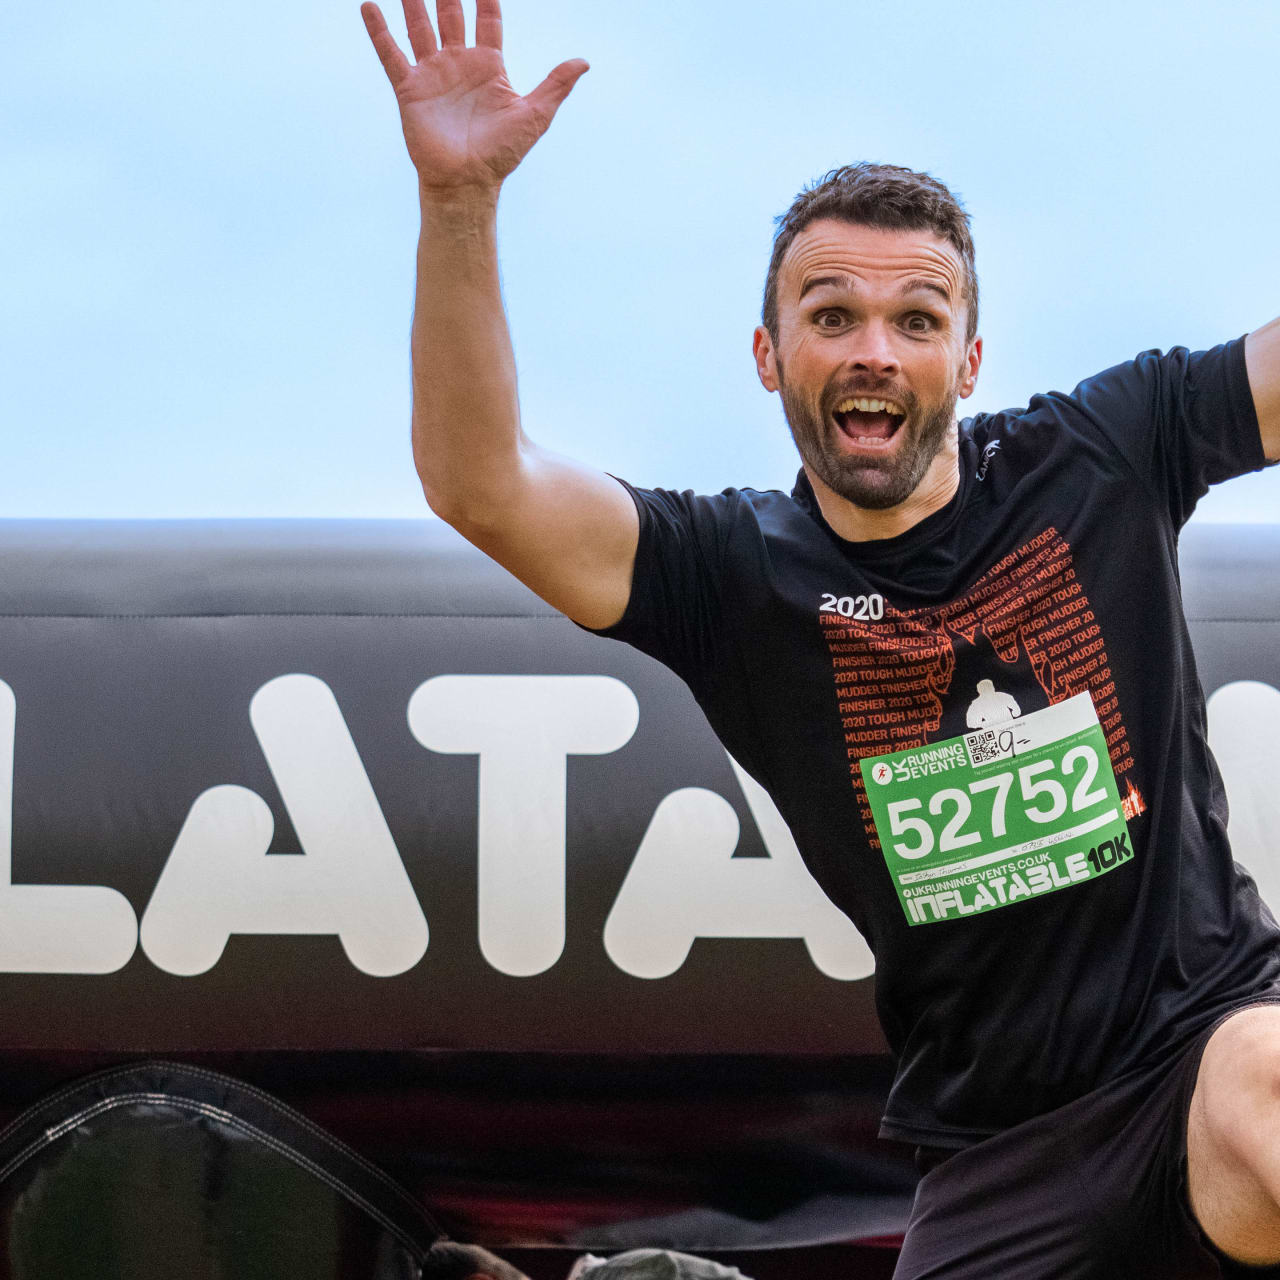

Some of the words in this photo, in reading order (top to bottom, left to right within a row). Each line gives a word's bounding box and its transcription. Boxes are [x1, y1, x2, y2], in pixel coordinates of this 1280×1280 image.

[1017, 527, 1059, 558] MUDDER
[969, 575, 1011, 604] MUDDER
[1009, 547, 1052, 581] FINISHER
[819, 593, 884, 620] 2020
[975, 586, 1021, 617] FINISHER
[1047, 596, 1089, 622] MUDDER
[870, 623, 896, 634] 2020
[987, 608, 1031, 636] FINISHER
[1032, 597, 1052, 615] 2020
[824, 629, 846, 640] 2020
[1038, 616, 1082, 644] FINISHER
[828, 643, 867, 653] MUDDER
[832, 655, 876, 668] FINISHER
[876, 654, 900, 665] 2020
[899, 646, 939, 662] TOUGH
[1047, 638, 1072, 658] 2020
[1068, 638, 1105, 665] MUDDER
[833, 670, 859, 684] 2020
[859, 666, 895, 681] TOUGH
[1056, 662, 1099, 687] FINISHER
[836, 684, 880, 699] MUDDER
[880, 677, 930, 695] FINISHER
[839, 697, 887, 713] FINISHER
[888, 695, 913, 708] 2020
[842, 715, 866, 729] 2020
[867, 711, 906, 725] TOUGH
[844, 728, 888, 743] MUDDER
[847, 743, 893, 759] FINISHER
[907, 743, 964, 767] RUNNING
[910, 755, 968, 780] EVENTS
[887, 745, 1109, 861] 52752
[906, 852, 1091, 923] INFLATABLE
[1087, 831, 1131, 873] 10K
[911, 852, 1052, 897] UKRUNNINGEVENTS.CO.UK
